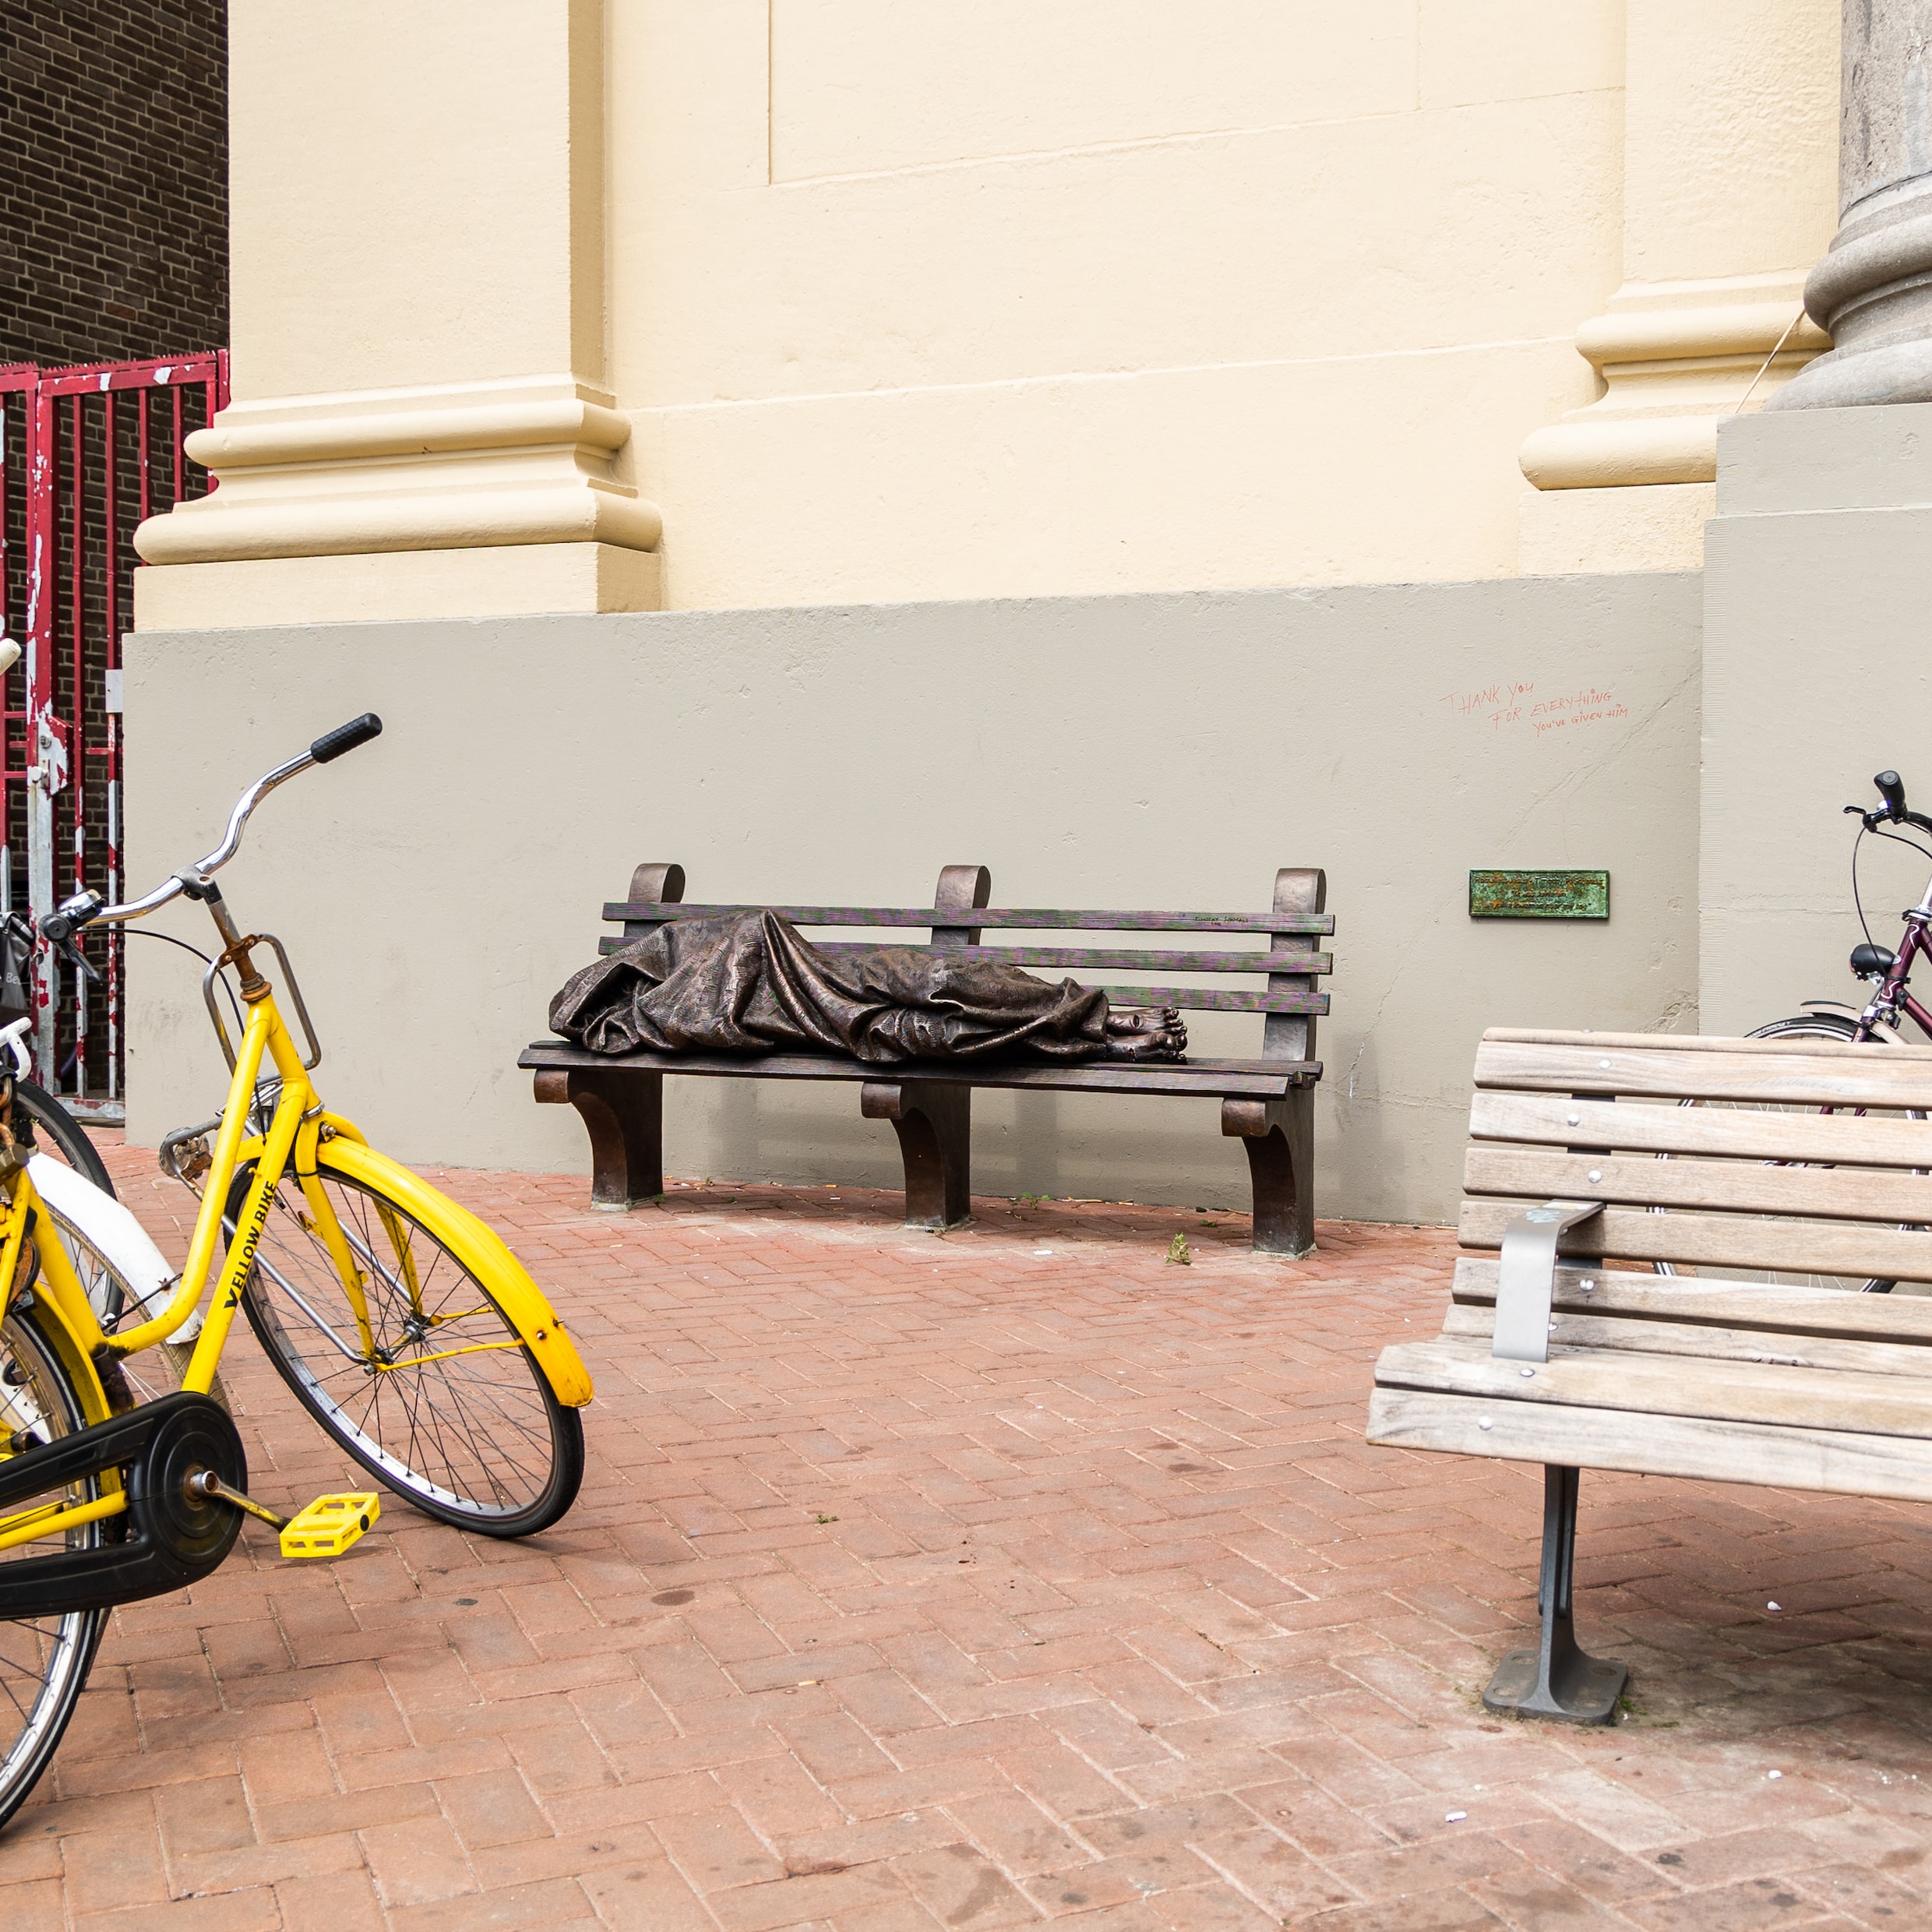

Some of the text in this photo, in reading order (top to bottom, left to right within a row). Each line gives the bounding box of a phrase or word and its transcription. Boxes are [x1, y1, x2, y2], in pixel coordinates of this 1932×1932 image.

[1439, 685, 1501, 722] THANK
[224, 1180, 276, 1309] YELLOW BIKE
